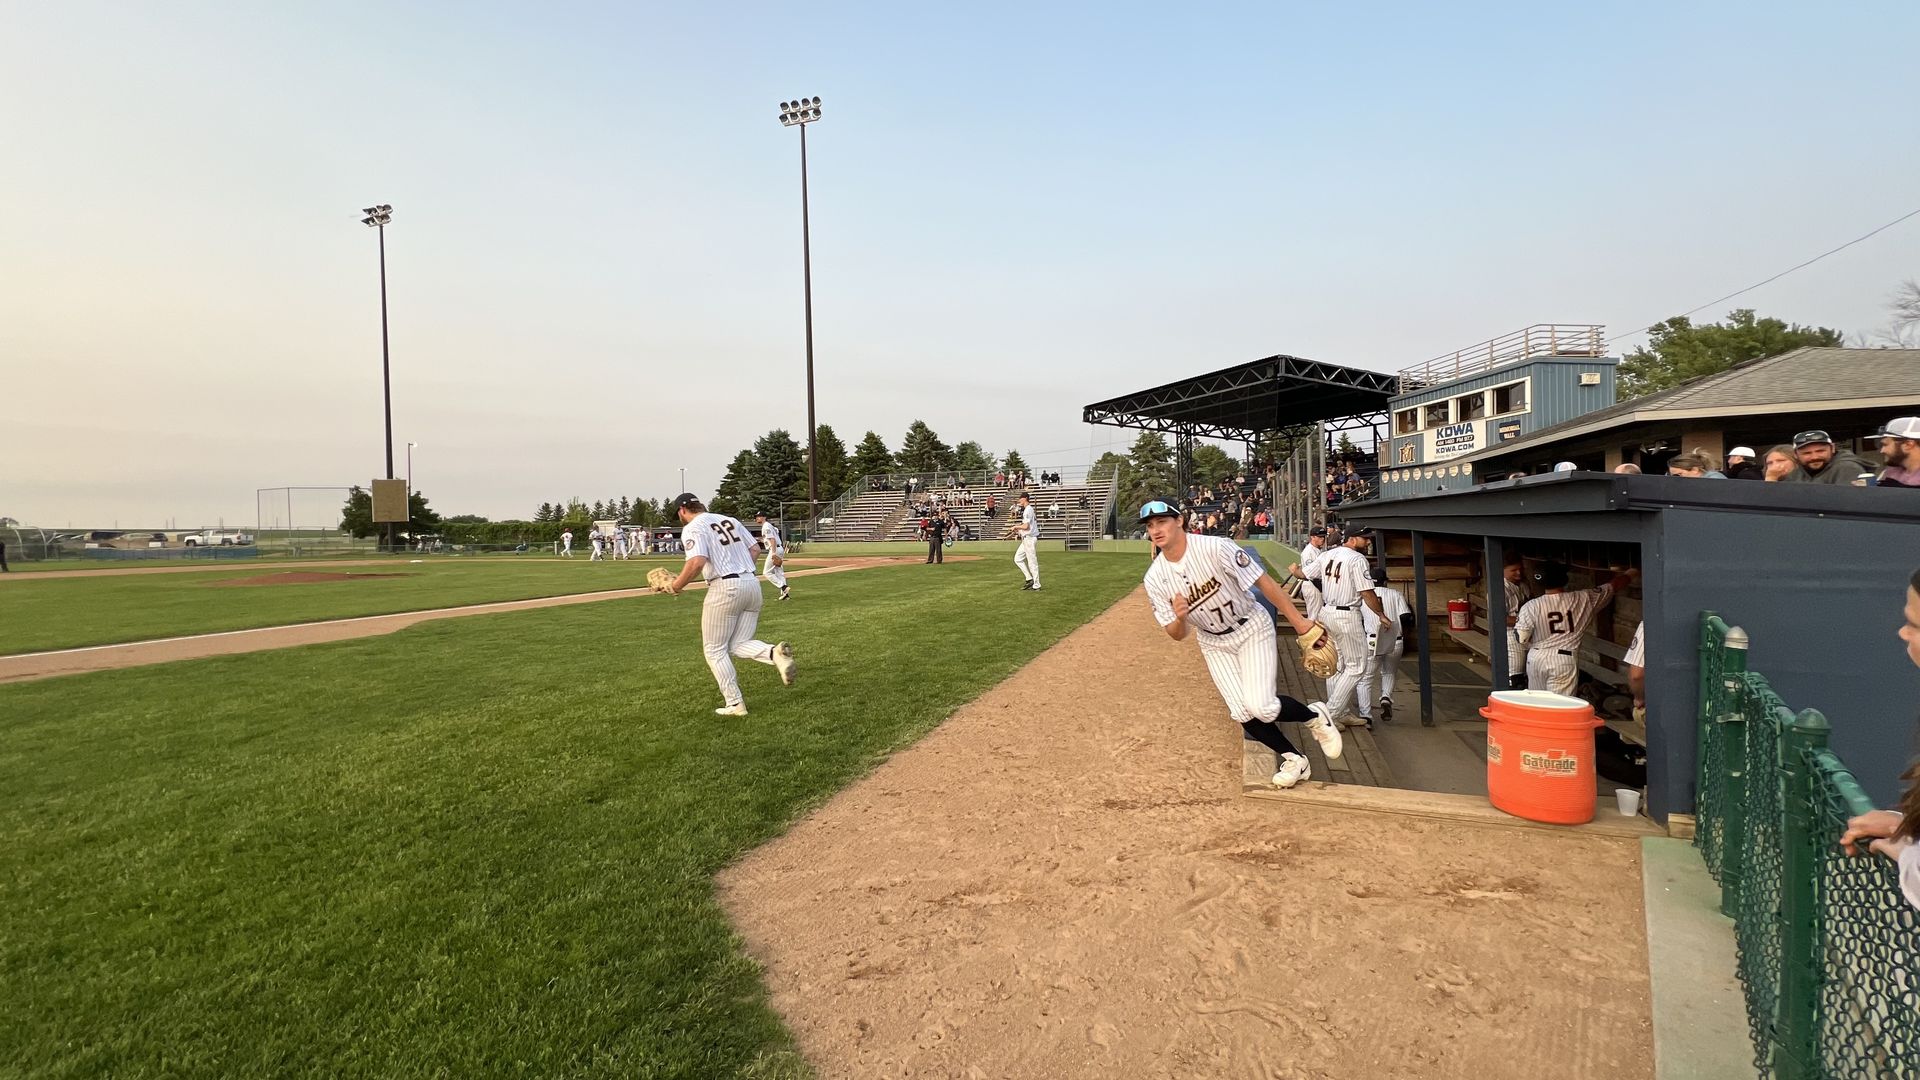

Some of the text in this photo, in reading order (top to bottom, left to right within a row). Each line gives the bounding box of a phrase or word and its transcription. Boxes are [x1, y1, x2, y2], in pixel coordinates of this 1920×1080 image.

[710, 519, 741, 546] 32
[1325, 559, 1342, 583] 44
[1211, 600, 1236, 623] 77
[1547, 610, 1575, 634] 21
[1523, 754, 1576, 770] Gatorade
